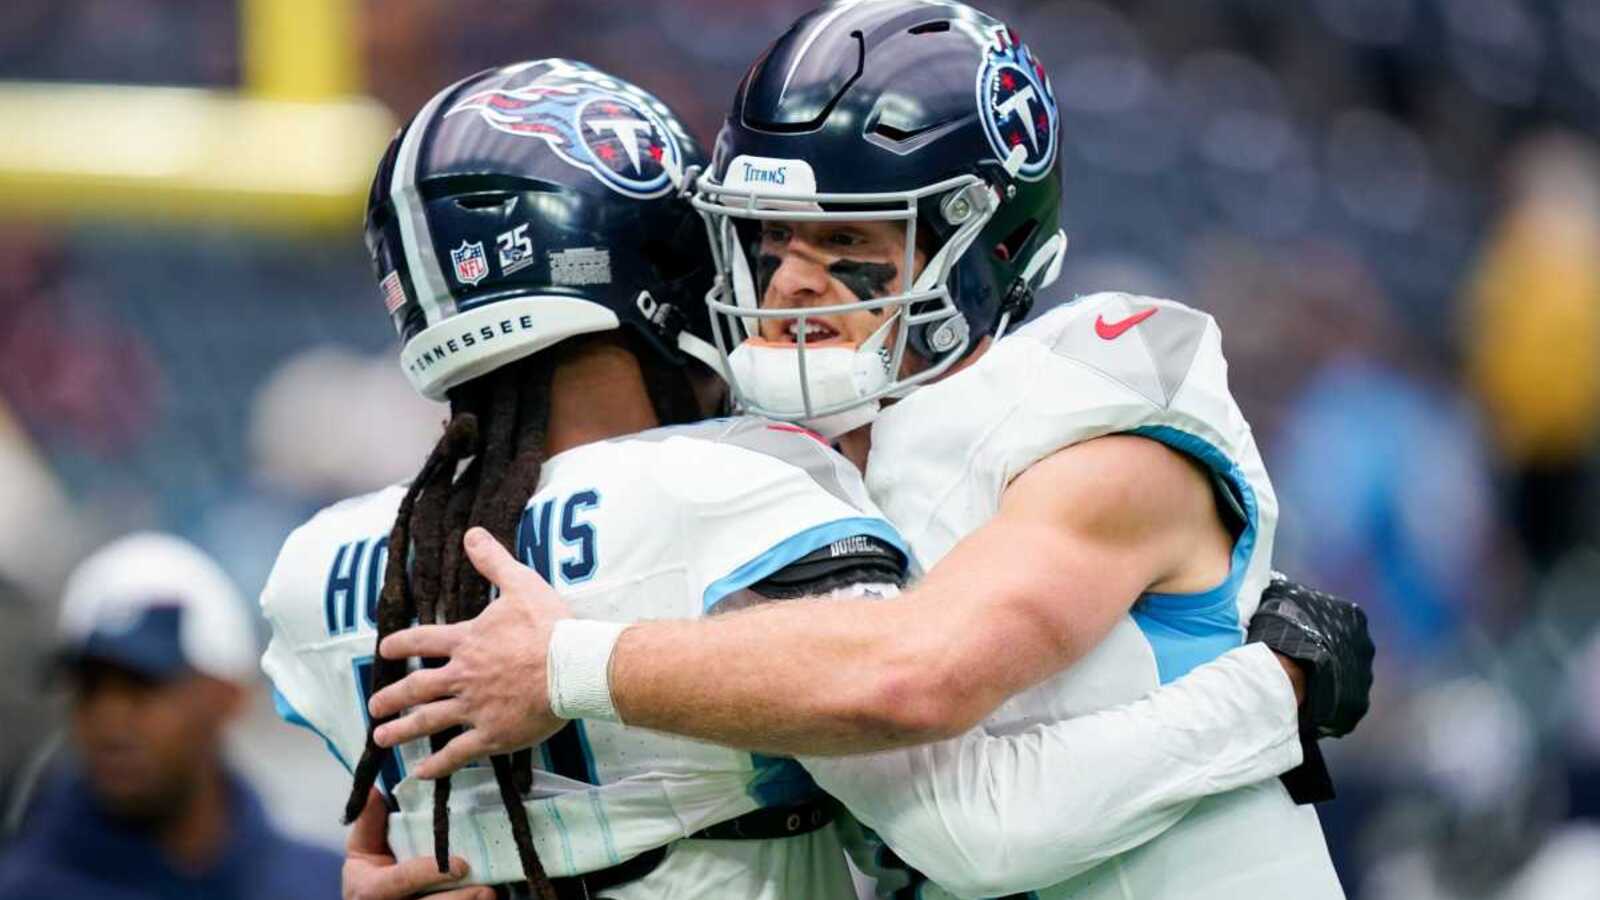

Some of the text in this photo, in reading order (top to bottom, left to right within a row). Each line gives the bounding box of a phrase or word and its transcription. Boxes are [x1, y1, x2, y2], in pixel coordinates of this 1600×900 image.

[743, 162, 786, 185] TITANS
[458, 258, 484, 278] NFL
[324, 487, 601, 636] HONS
